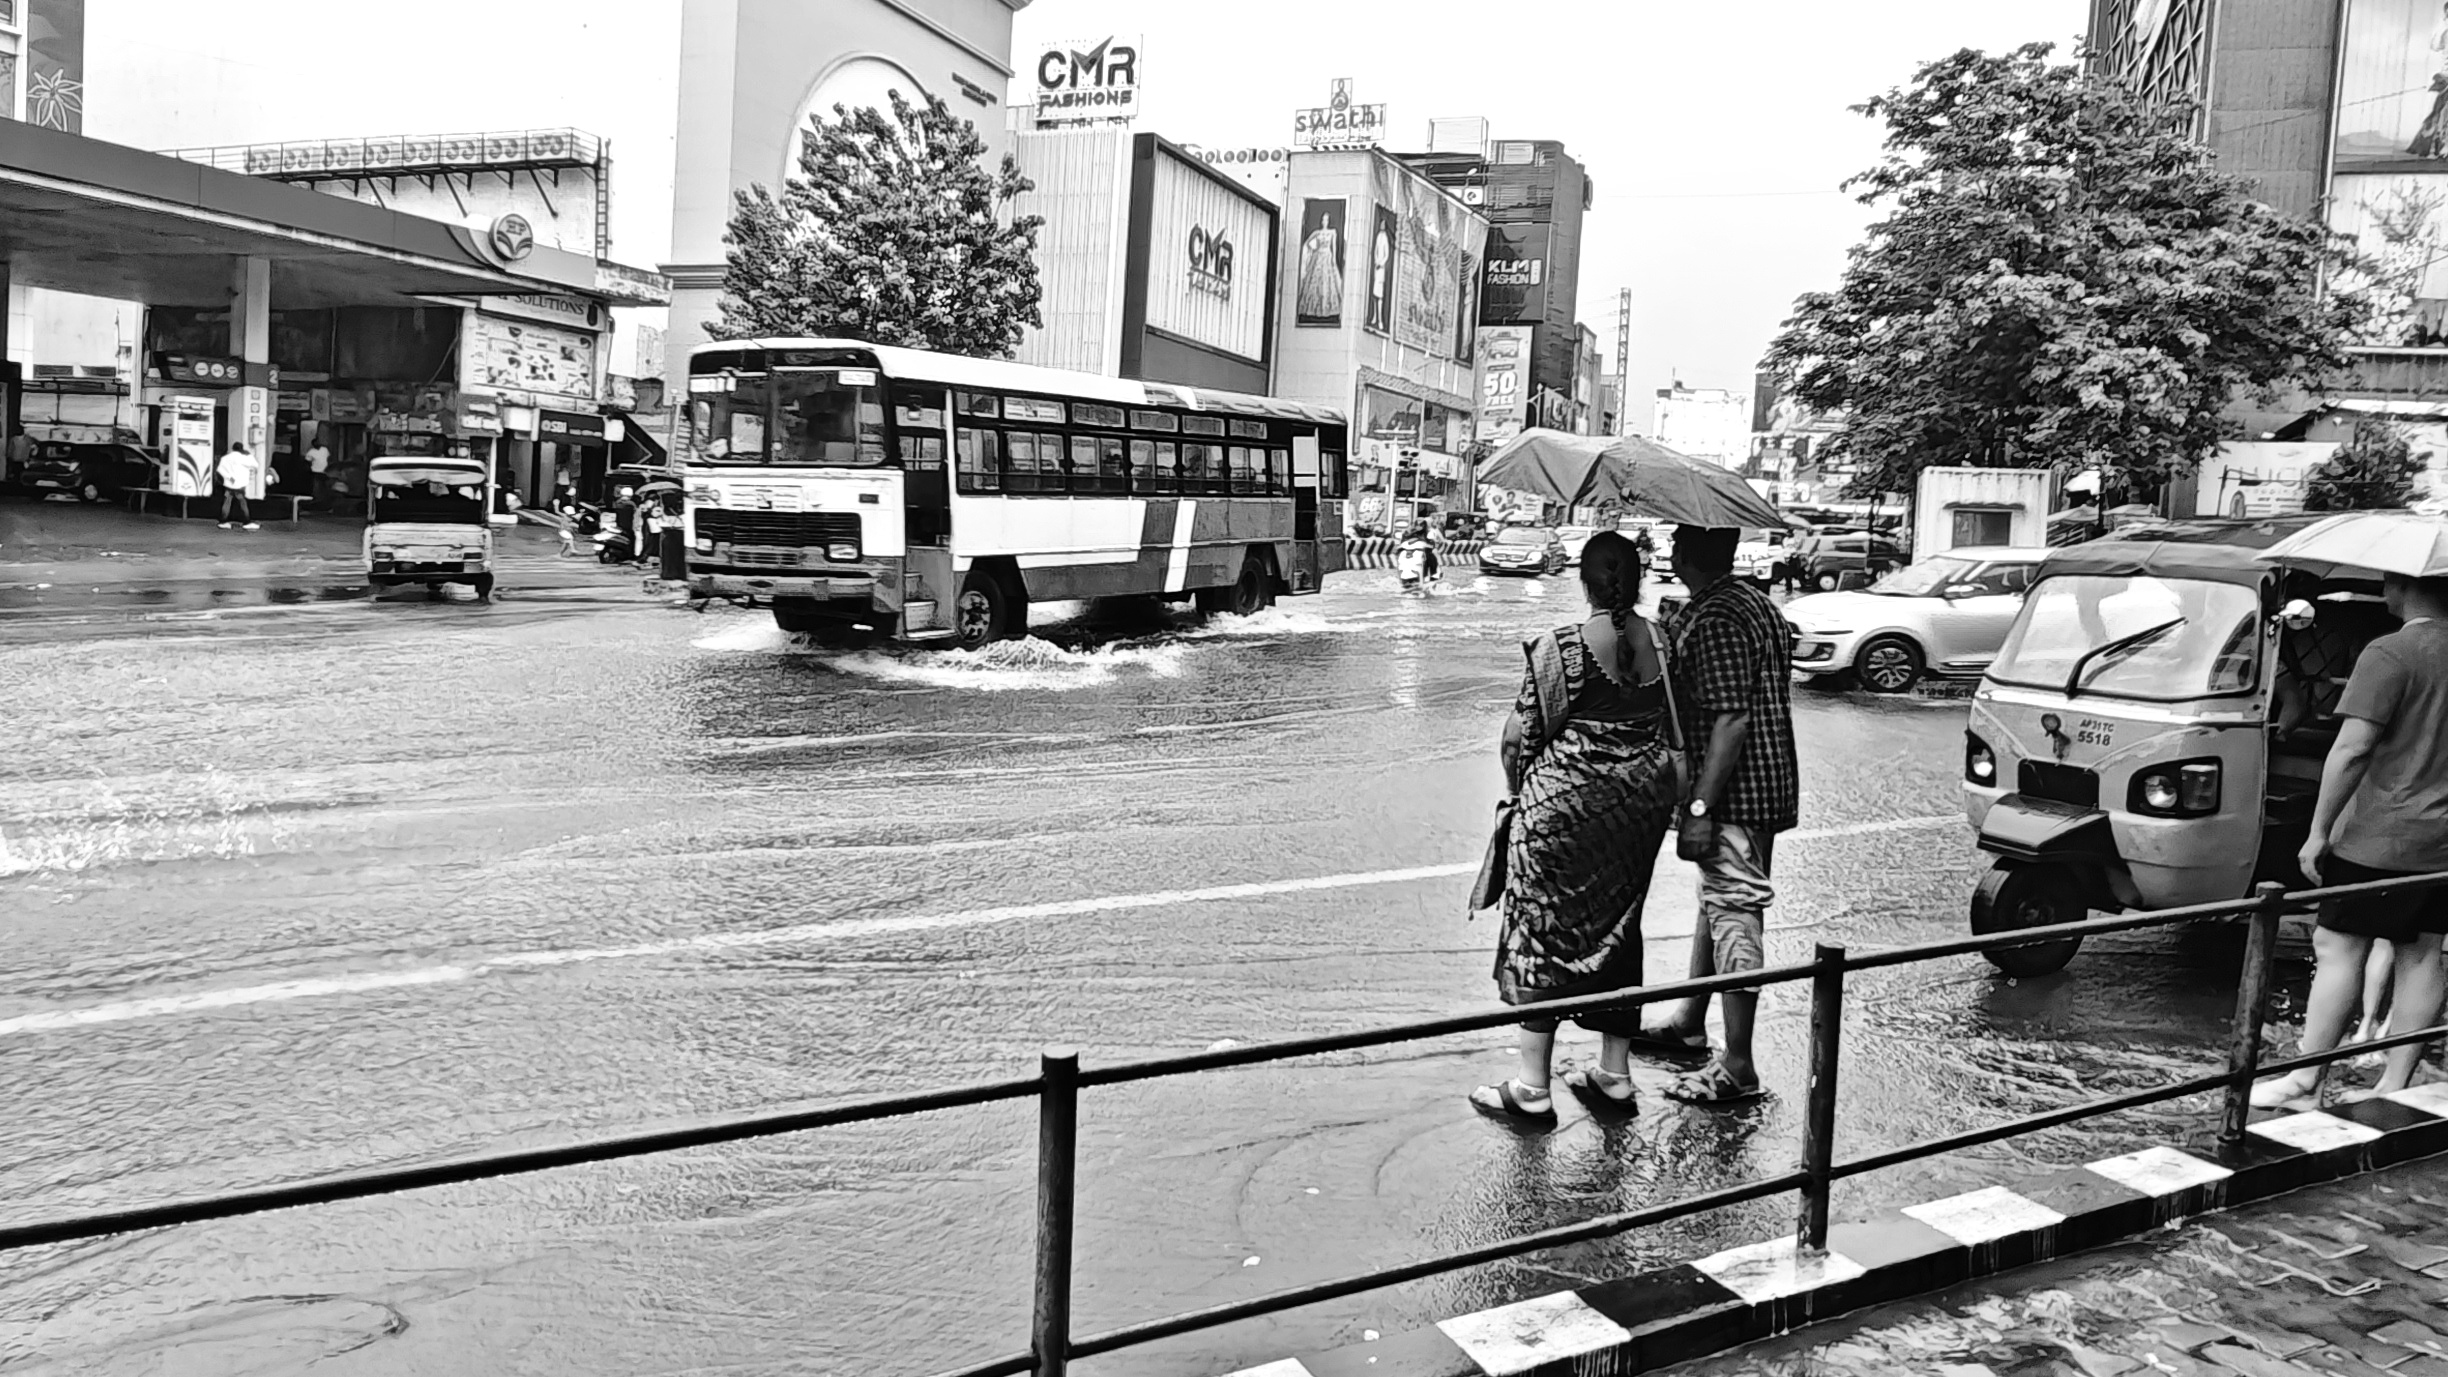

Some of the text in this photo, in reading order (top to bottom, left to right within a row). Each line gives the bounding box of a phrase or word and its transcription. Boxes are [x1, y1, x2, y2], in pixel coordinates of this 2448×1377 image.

[1038, 35, 1136, 89] CMR
[1038, 89, 1132, 117] FASHIONS
[1296, 104, 1384, 133] swathi
[1188, 223, 1233, 282] CMR
[1488, 260, 1530, 273] KLM
[1487, 273, 1530, 285] FASHION
[269, 369, 278, 384] 2
[2078, 730, 2111, 746] 5518
